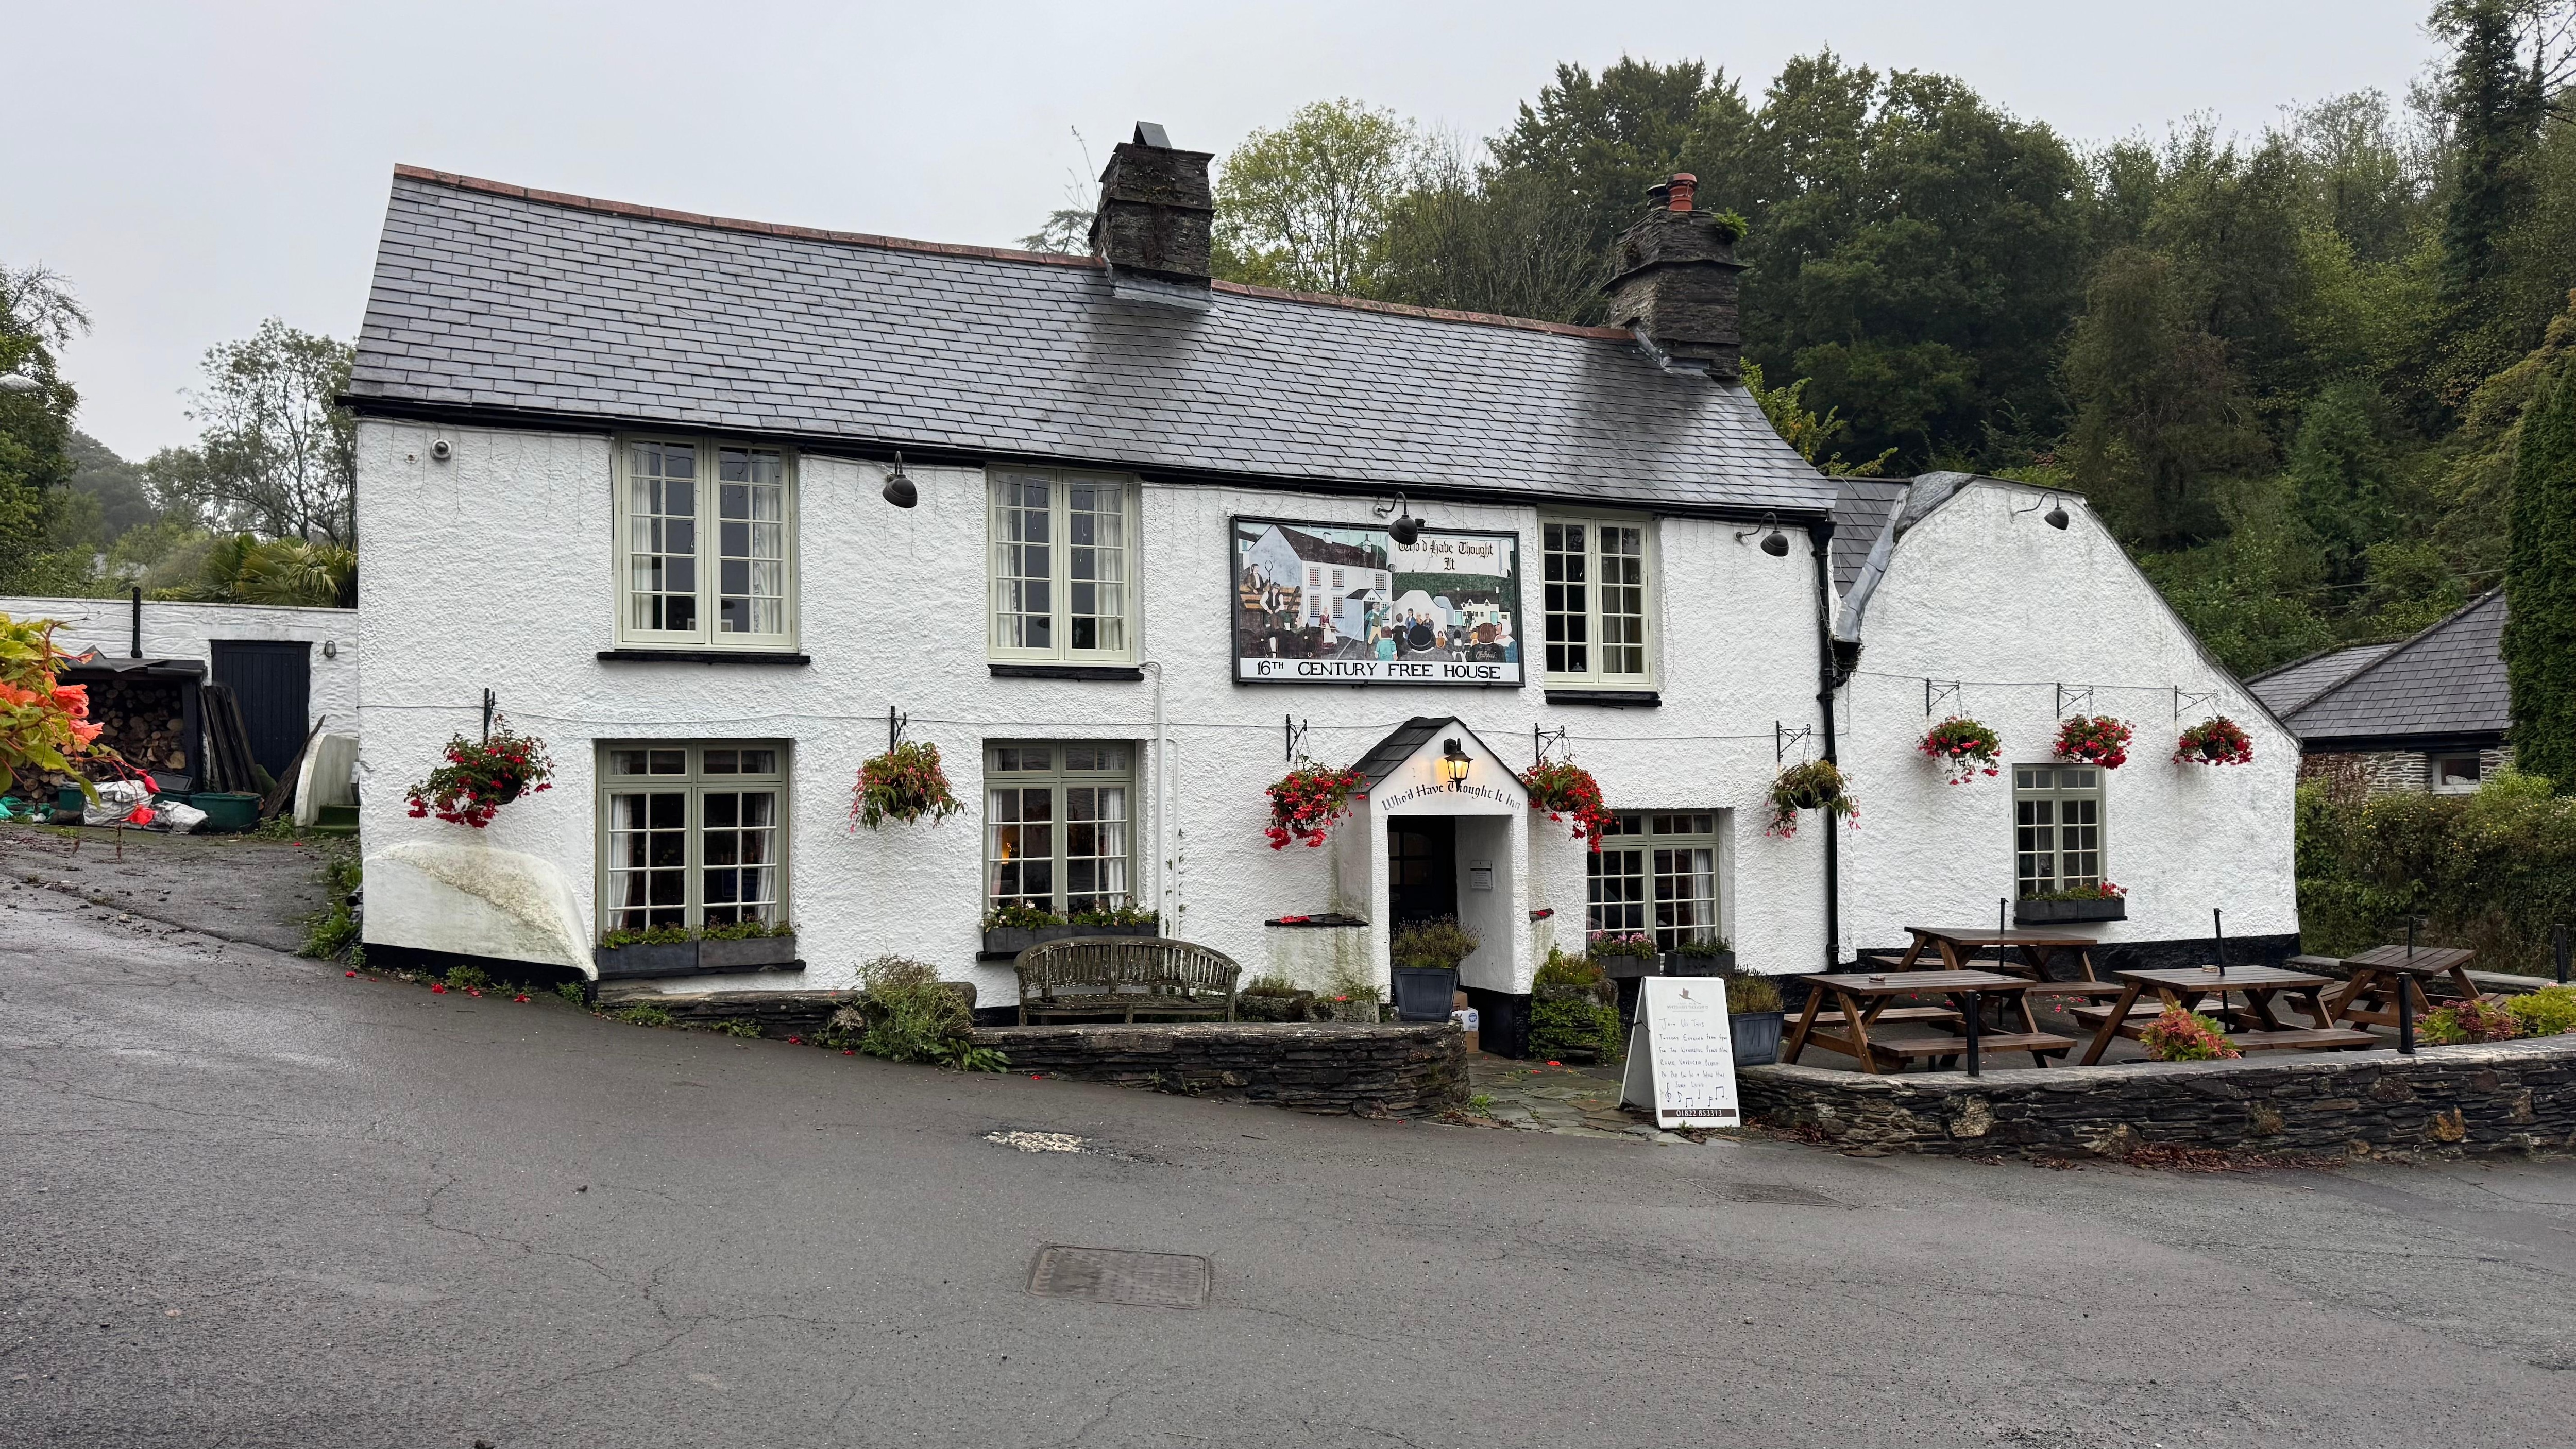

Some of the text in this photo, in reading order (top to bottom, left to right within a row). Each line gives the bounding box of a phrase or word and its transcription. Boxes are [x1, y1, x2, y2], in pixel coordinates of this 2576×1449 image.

[1430, 540, 1453, 557] Have
[1459, 541, 1494, 559] Thought
[1444, 557, 1455, 570] It
[1298, 661, 1377, 676] CENTURY
[1388, 663, 1433, 677] FREE
[1444, 664, 1500, 679] HOUSE
[1381, 780, 1521, 811] Who'd Have Thought It Inn
